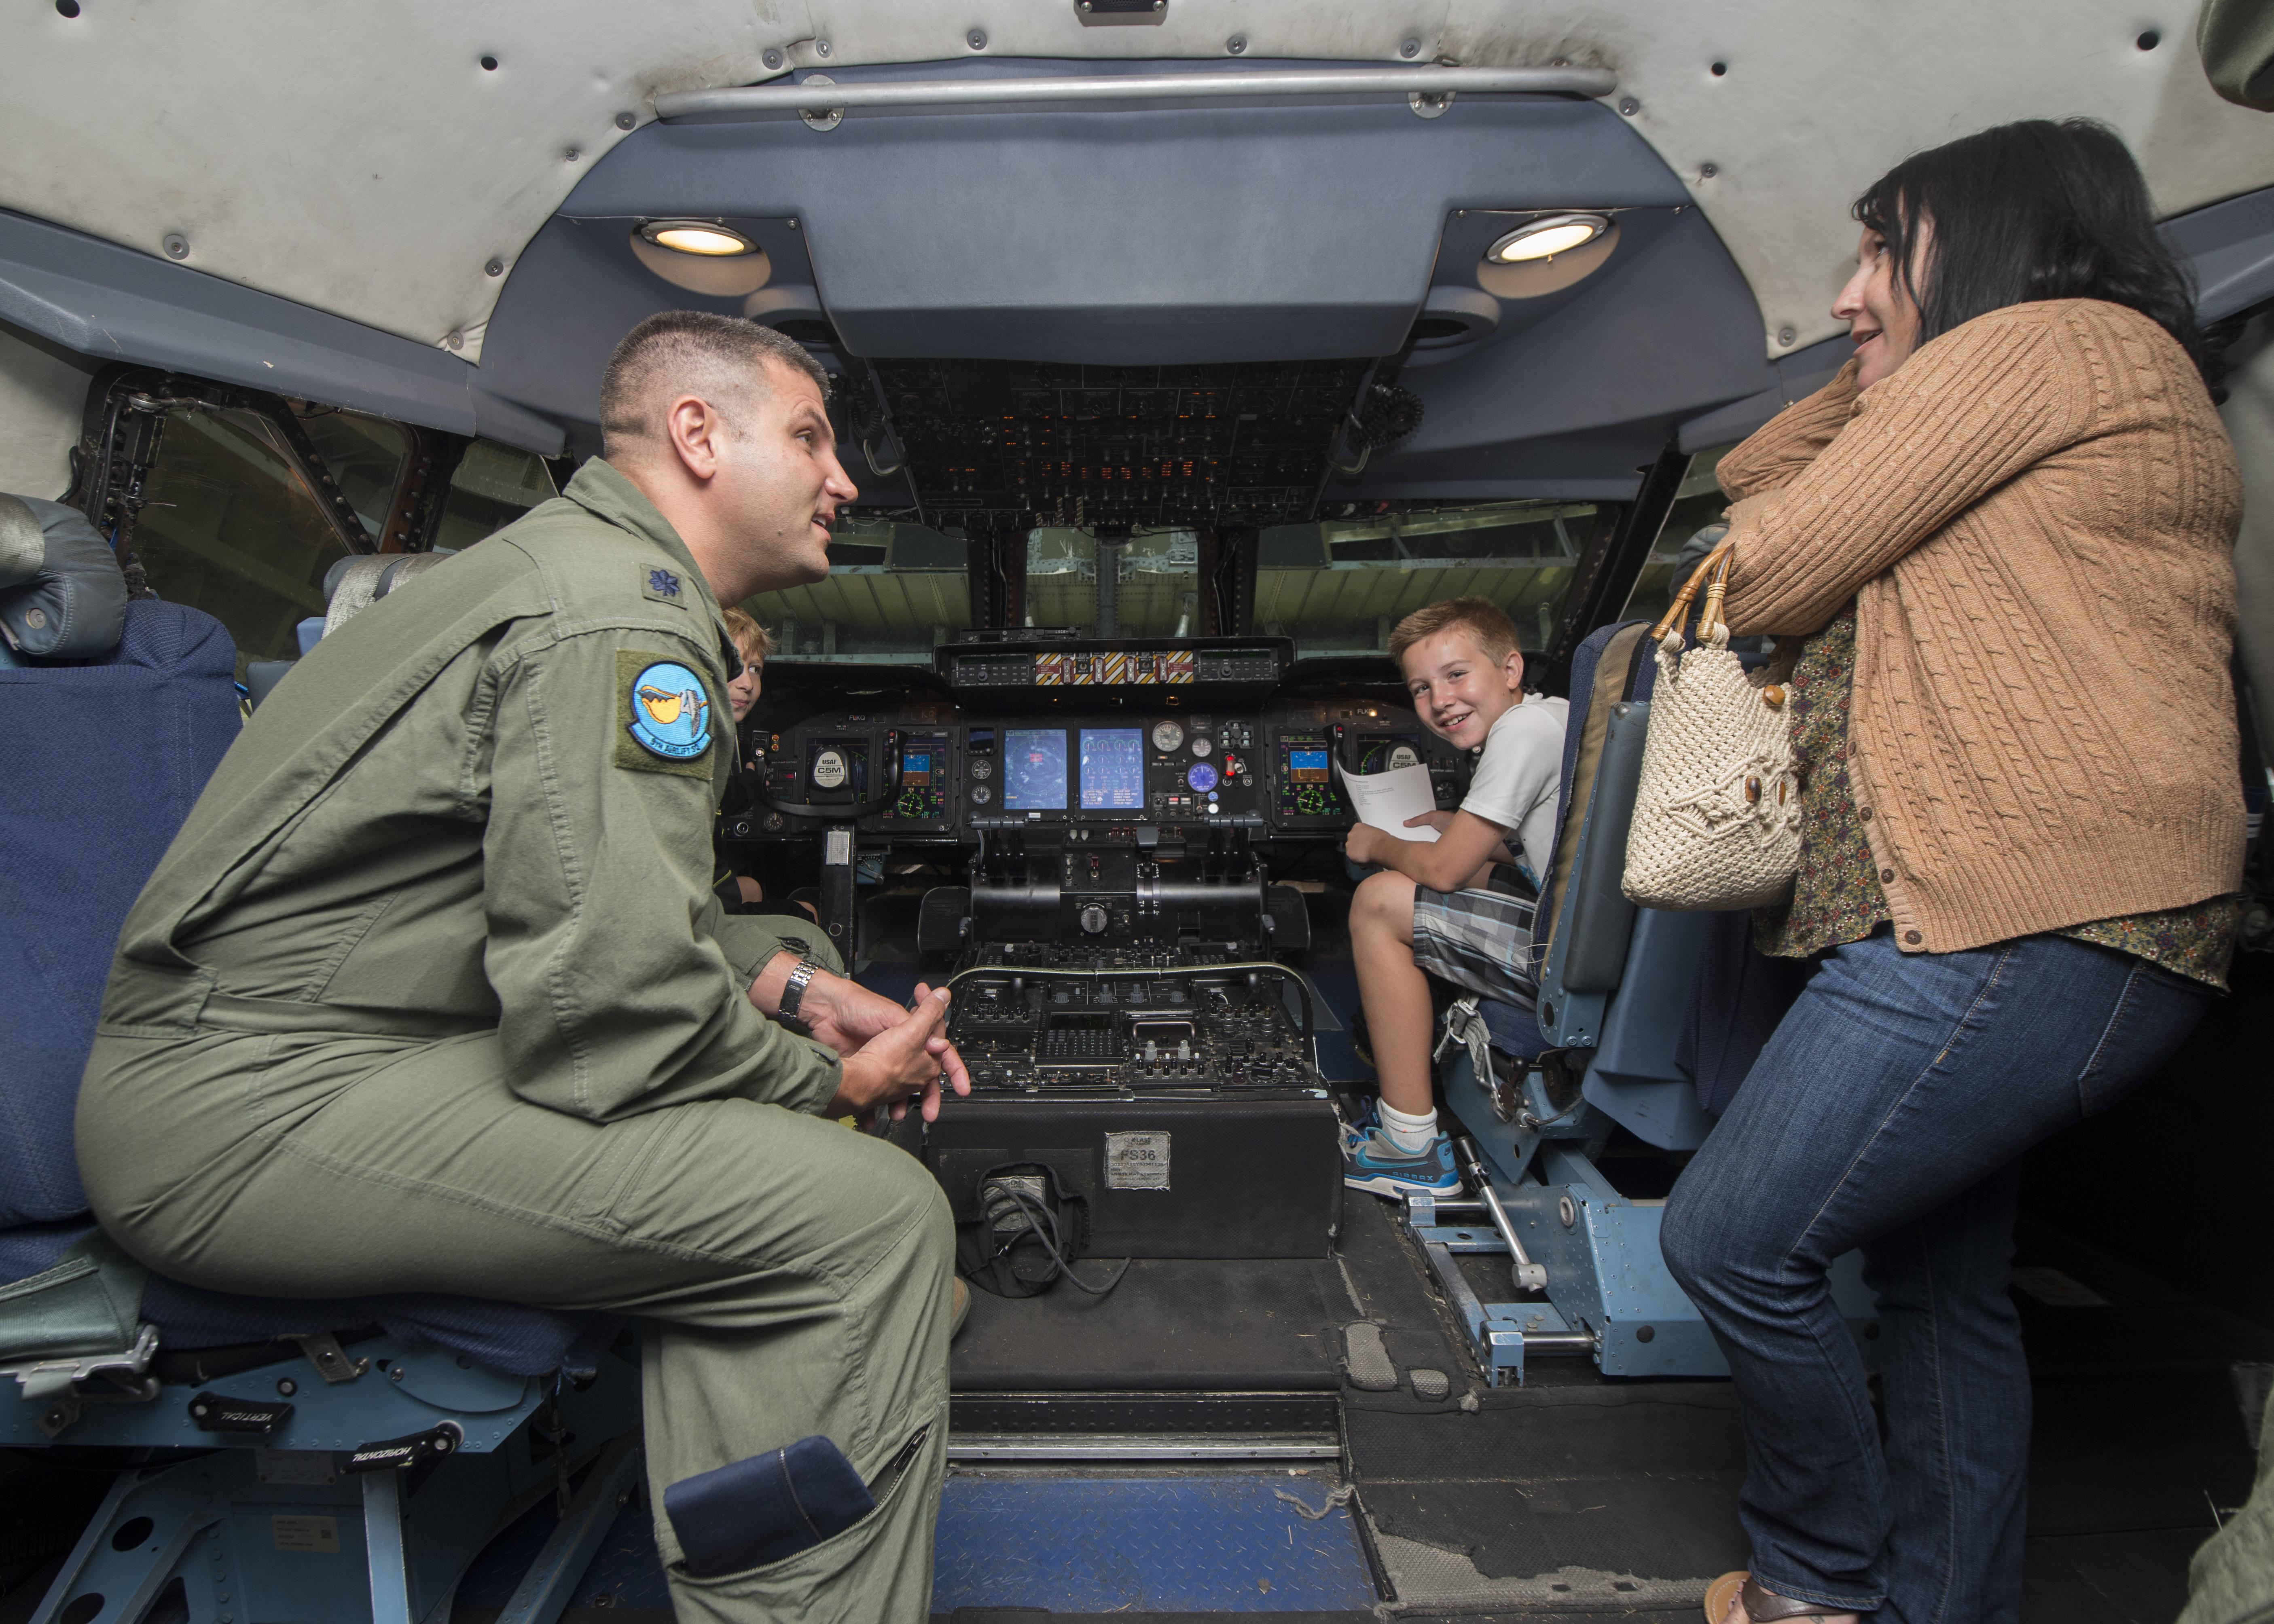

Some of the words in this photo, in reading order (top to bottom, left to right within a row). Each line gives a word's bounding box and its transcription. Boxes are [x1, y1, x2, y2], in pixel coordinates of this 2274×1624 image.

[1120, 1149, 1156, 1161] FS36
[1392, 1171, 1433, 1181] AIRMAX
[221, 1411, 273, 1423] VERTICAL
[351, 1446, 413, 1462] HORIZONTAL
